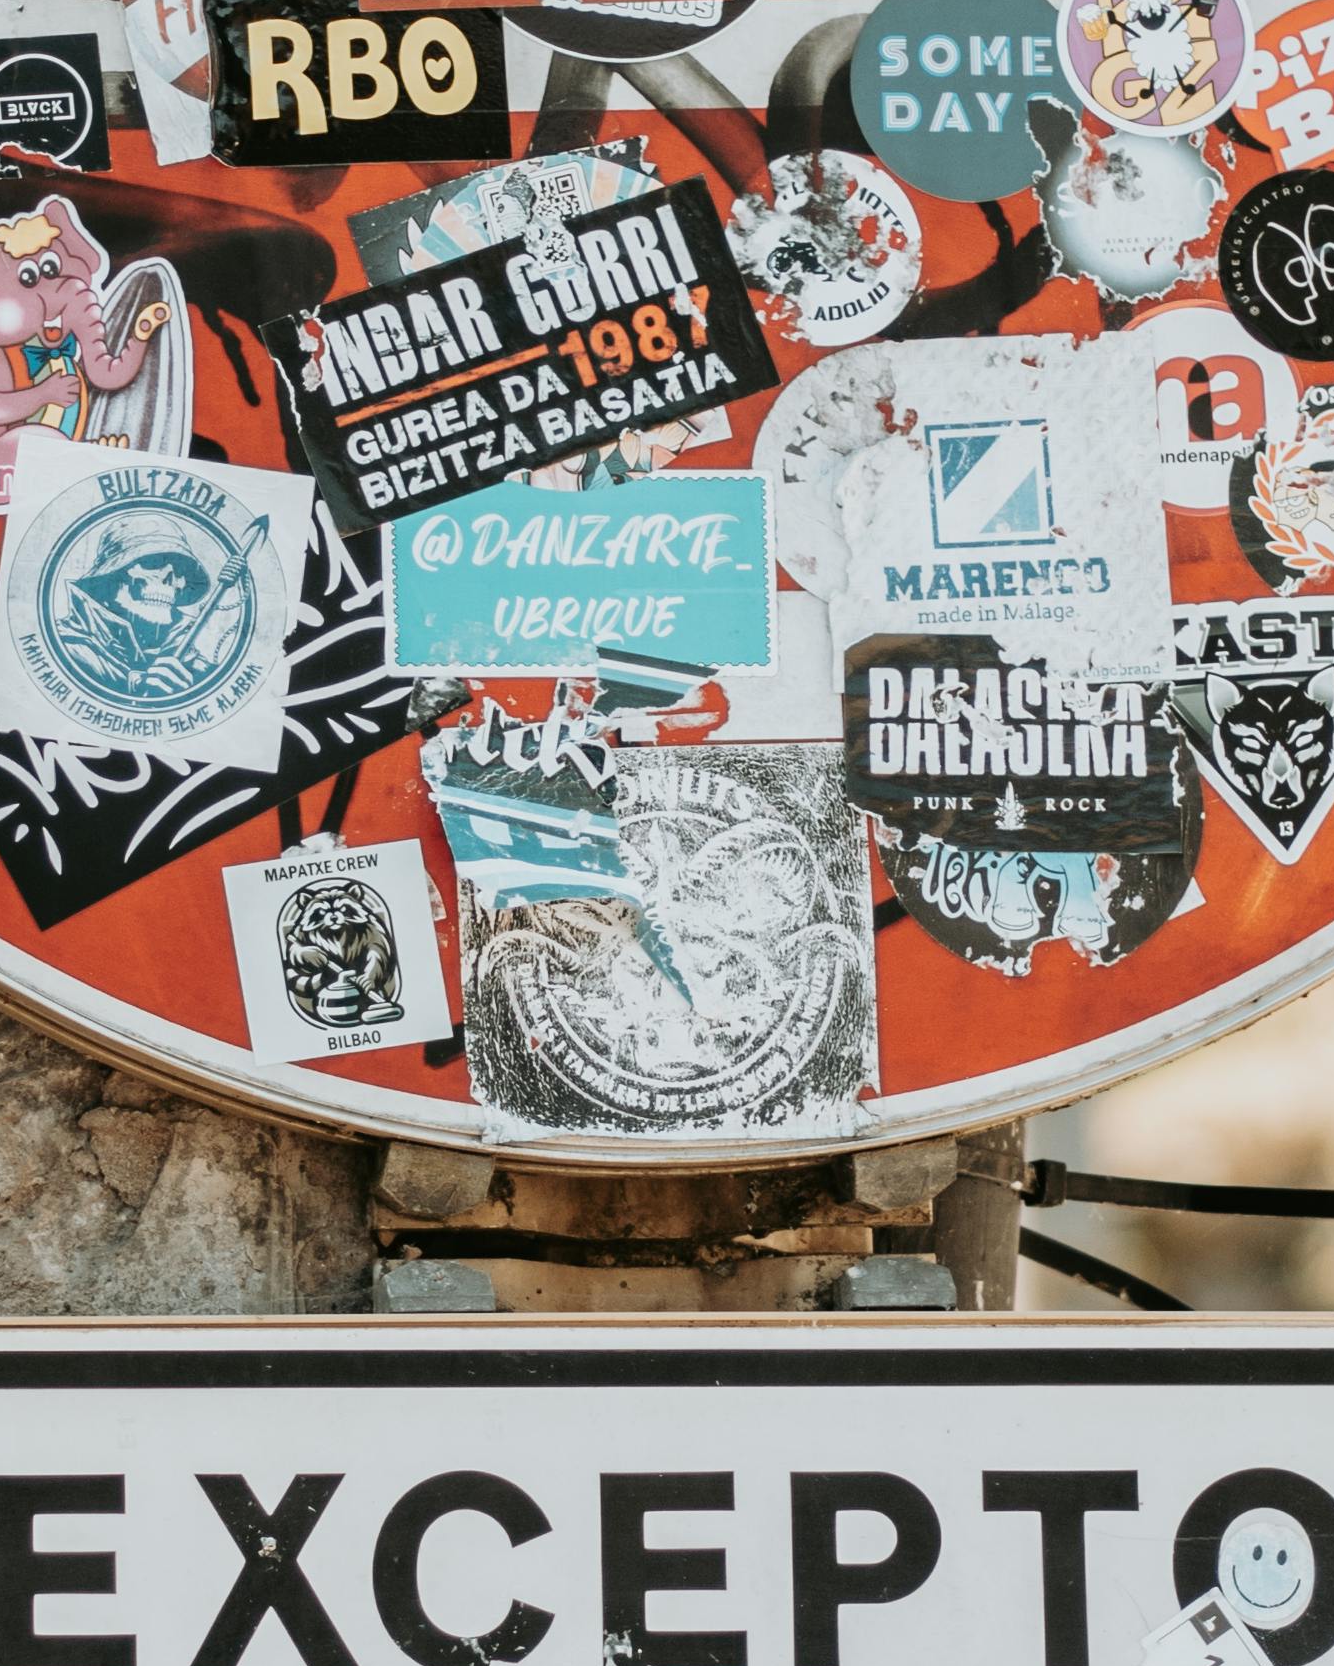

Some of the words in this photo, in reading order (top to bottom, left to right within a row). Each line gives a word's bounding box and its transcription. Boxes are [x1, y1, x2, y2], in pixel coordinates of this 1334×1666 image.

[247, 16, 478, 137] RBO
[879, 35, 1054, 77] SOME
[881, 92, 1053, 134] DAY
[813, 282, 891, 321] ADOLID
[316, 275, 503, 407] INDAR
[347, 382, 501, 466] GUREA
[501, 363, 570, 416] DA
[358, 416, 538, 511] BIZITZA
[97, 469, 230, 519] BULTZADA
[492, 593, 686, 646] UBRIQUE
[918, 605, 972, 625] made
[978, 604, 998, 622] in
[18, 632, 74, 706] KANTAURI
[67, 697, 165, 738] ITSASOAREN
[913, 796, 975, 813] PUNK
[1045, 796, 1108, 813] ROCK
[1279, 820, 1294, 838] 13
[264, 860, 333, 883] MAPATXE
[336, 853, 380, 873] CREW
[328, 1030, 383, 1051] BILBAO
